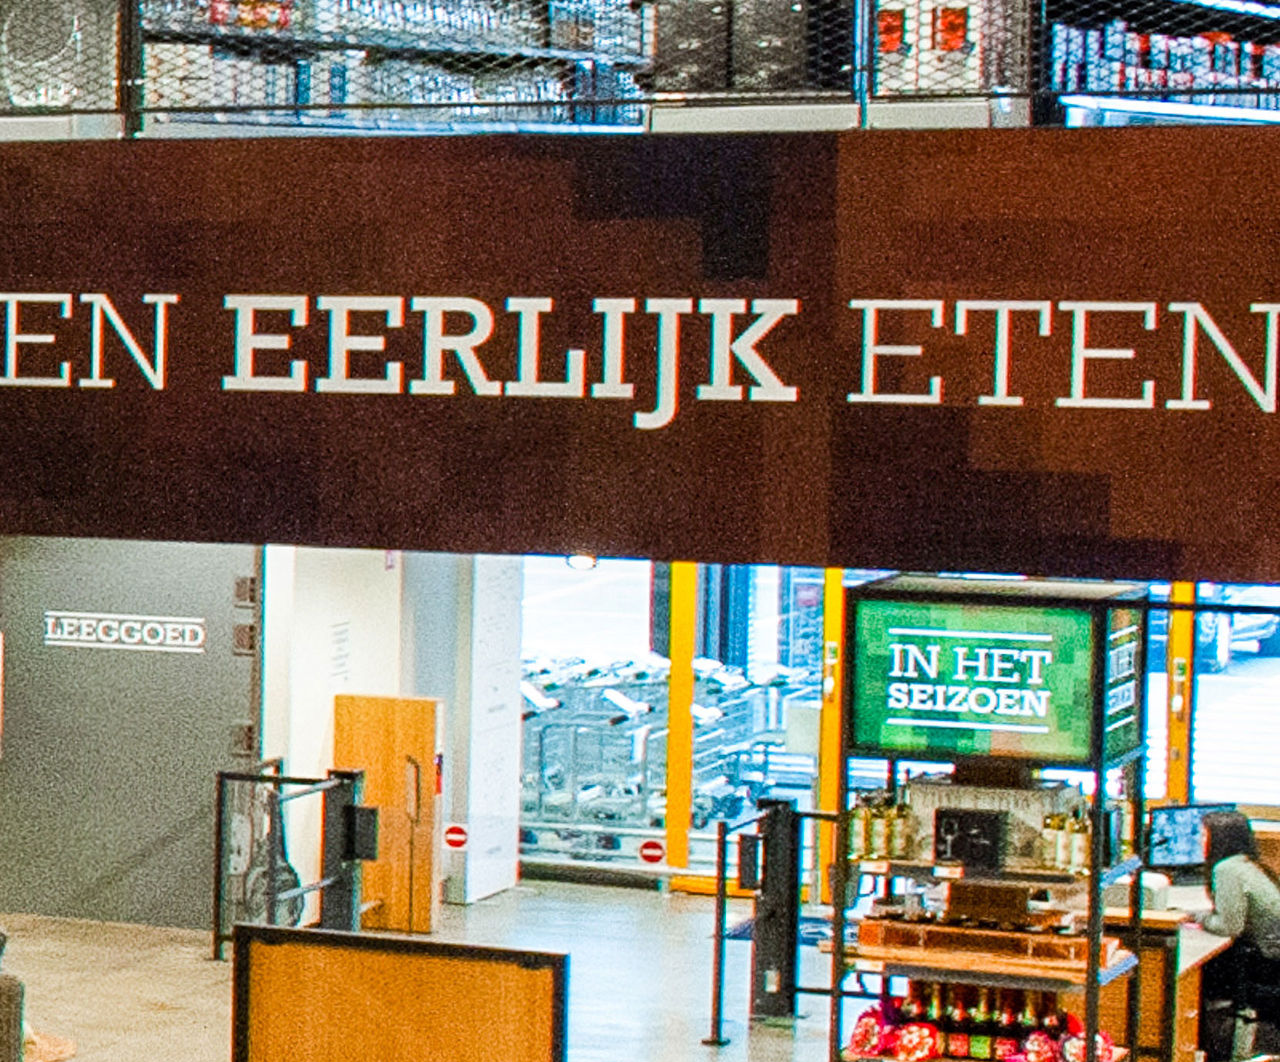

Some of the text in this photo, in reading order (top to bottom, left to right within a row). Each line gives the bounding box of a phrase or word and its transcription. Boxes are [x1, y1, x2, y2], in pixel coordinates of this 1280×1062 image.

[222, 293, 802, 431] EERLIJK
[847, 298, 1280, 414] ETEN
[45, 617, 207, 646] LEEGGOED
[888, 643, 1052, 684] IN HET
[888, 682, 1051, 717] SEIZOEN
